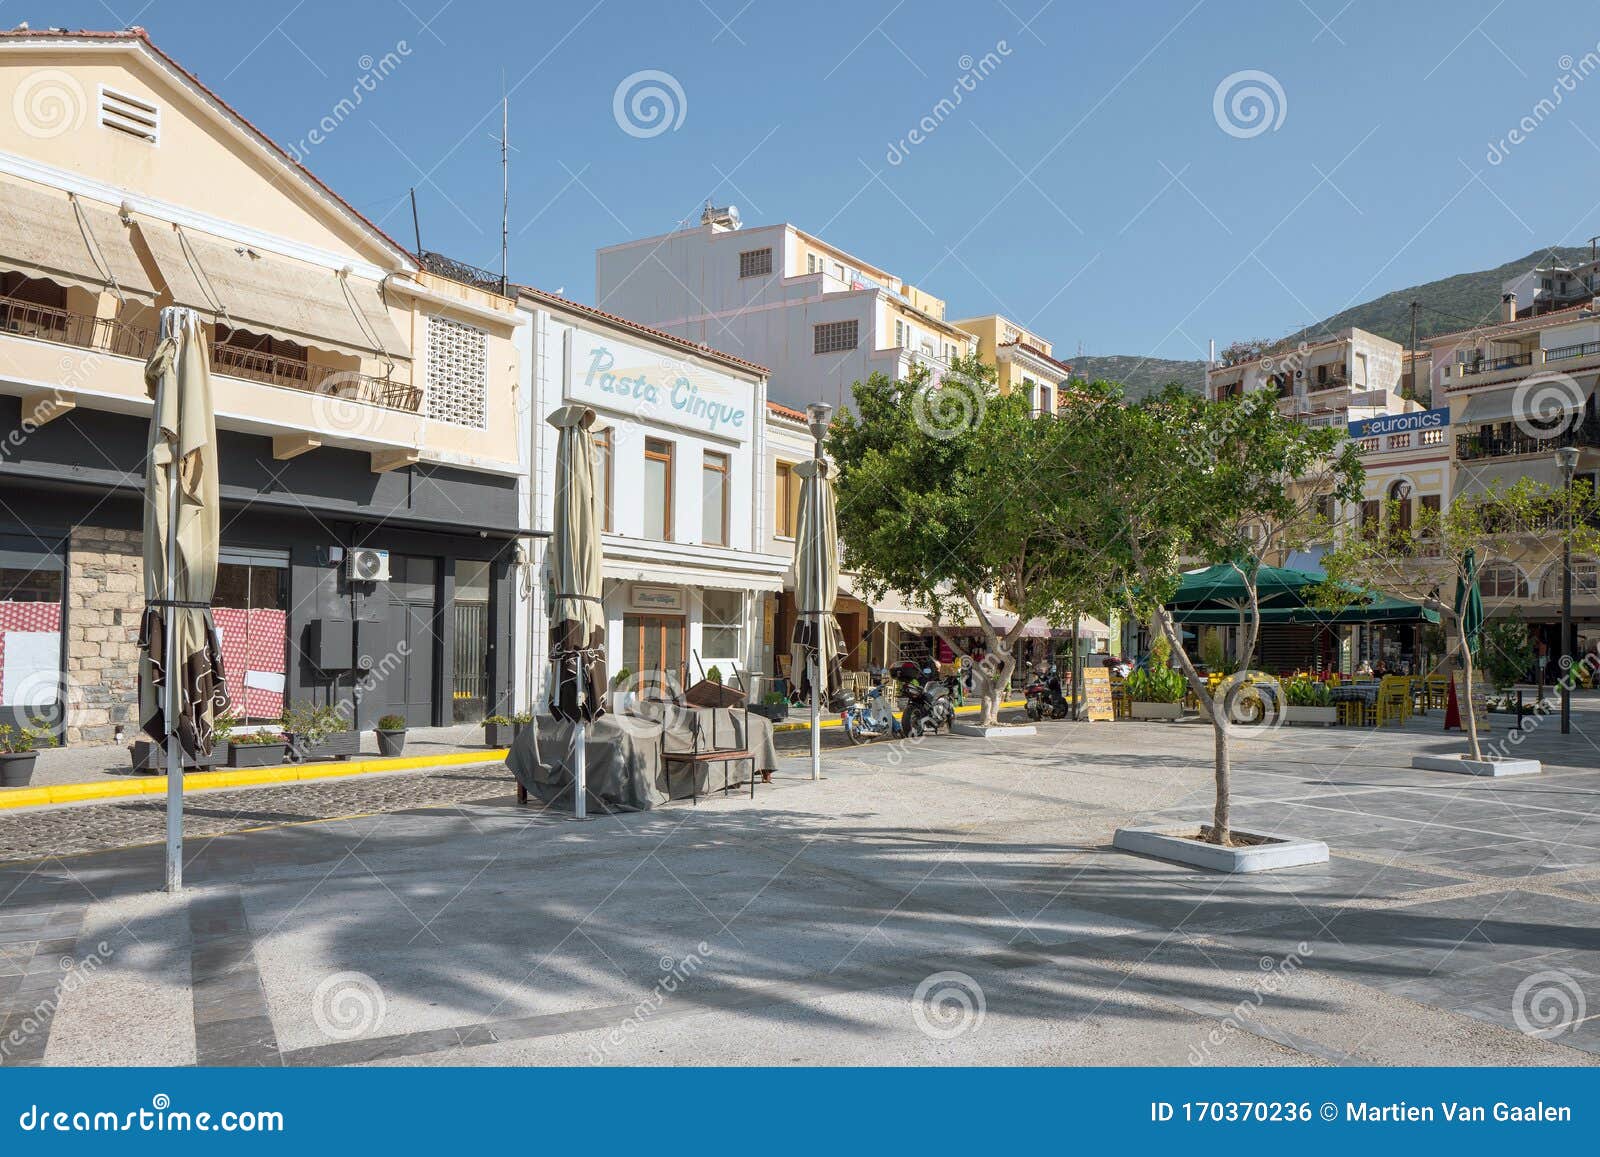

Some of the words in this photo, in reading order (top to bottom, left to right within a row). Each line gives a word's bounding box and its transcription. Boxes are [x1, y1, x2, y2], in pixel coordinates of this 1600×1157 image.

[584, 346, 657, 403] Pasta
[671, 377, 745, 430] Cinque
[1371, 412, 1441, 433] euronics
